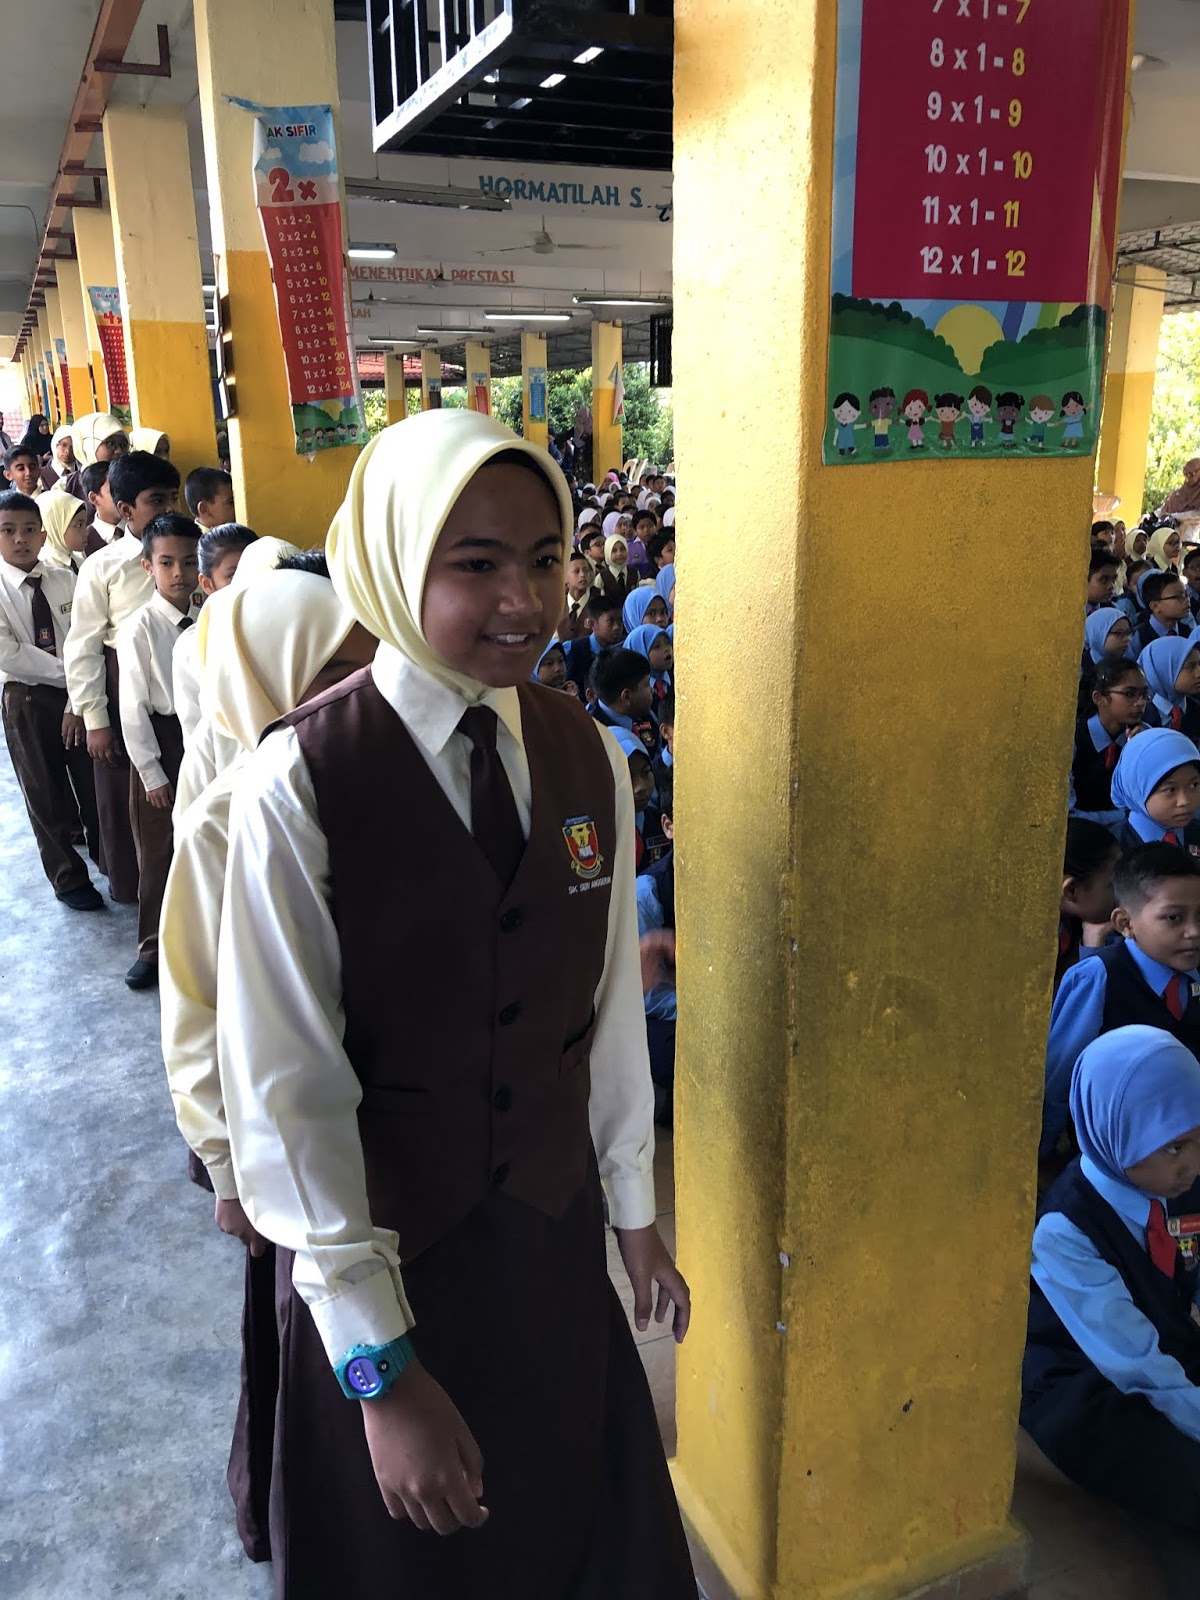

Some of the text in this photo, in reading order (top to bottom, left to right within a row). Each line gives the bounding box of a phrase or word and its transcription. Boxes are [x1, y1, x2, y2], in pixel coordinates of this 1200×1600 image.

[983, 0, 988, 19] 1
[1016, 0, 1030, 23] 7
[930, 38, 944, 67] 8
[977, 43, 986, 71] 1
[1012, 48, 1025, 75] 8
[927, 91, 942, 120] 9
[974, 95, 983, 123] 1
[1009, 99, 1021, 127] 9
[267, 124, 316, 138] AK SIFIR
[925, 144, 947, 173] 10
[979, 148, 987, 175] 1
[1013, 151, 1032, 179] 10
[268, 167, 295, 203] 2
[479, 175, 620, 206] HORMATILAH
[922, 196, 939, 224] 11
[970, 198, 978, 225] 1
[1004, 201, 1020, 227] 11
[275, 216, 280, 225] 1
[290, 215, 296, 225] 2
[305, 214, 312, 224] 2
[279, 232, 285, 241] 2
[295, 231, 301, 241] 2
[310, 230, 317, 239] 4
[281, 248, 288, 257] 3
[297, 247, 304, 257] 2
[313, 246, 319, 255] 6
[285, 264, 291, 273] 4
[300, 263, 307, 272] 2
[316, 261, 322, 270] 8
[920, 246, 943, 273] 12
[971, 248, 979, 275] 1
[1005, 250, 1026, 276] 12
[287, 279, 294, 289] 5
[303, 278, 310, 287] 2
[319, 276, 328, 286] 10
[450, 269, 516, 284] PRESTASI
[290, 295, 296, 304] 6
[306, 294, 312, 303] 2
[321, 292, 330, 301] 12
[103, 310, 114, 324] 4
[292, 310, 298, 320] 7
[308, 309, 315, 318] 2
[323, 307, 333, 316] 14
[295, 325, 301, 335] 8
[311, 324, 317, 333] 2
[326, 321, 335, 331] 16
[298, 341, 304, 350] 9
[314, 339, 320, 348] 2
[329, 337, 338, 346] 18
[300, 355, 310, 365] 10
[319, 353, 326, 363] 2
[334, 351, 345, 361] 20
[303, 370, 311, 380] 11
[320, 368, 327, 378] 2
[335, 366, 346, 376] 22
[307, 384, 316, 394] 12
[325, 383, 331, 392] 2
[340, 381, 351, 391] 24
